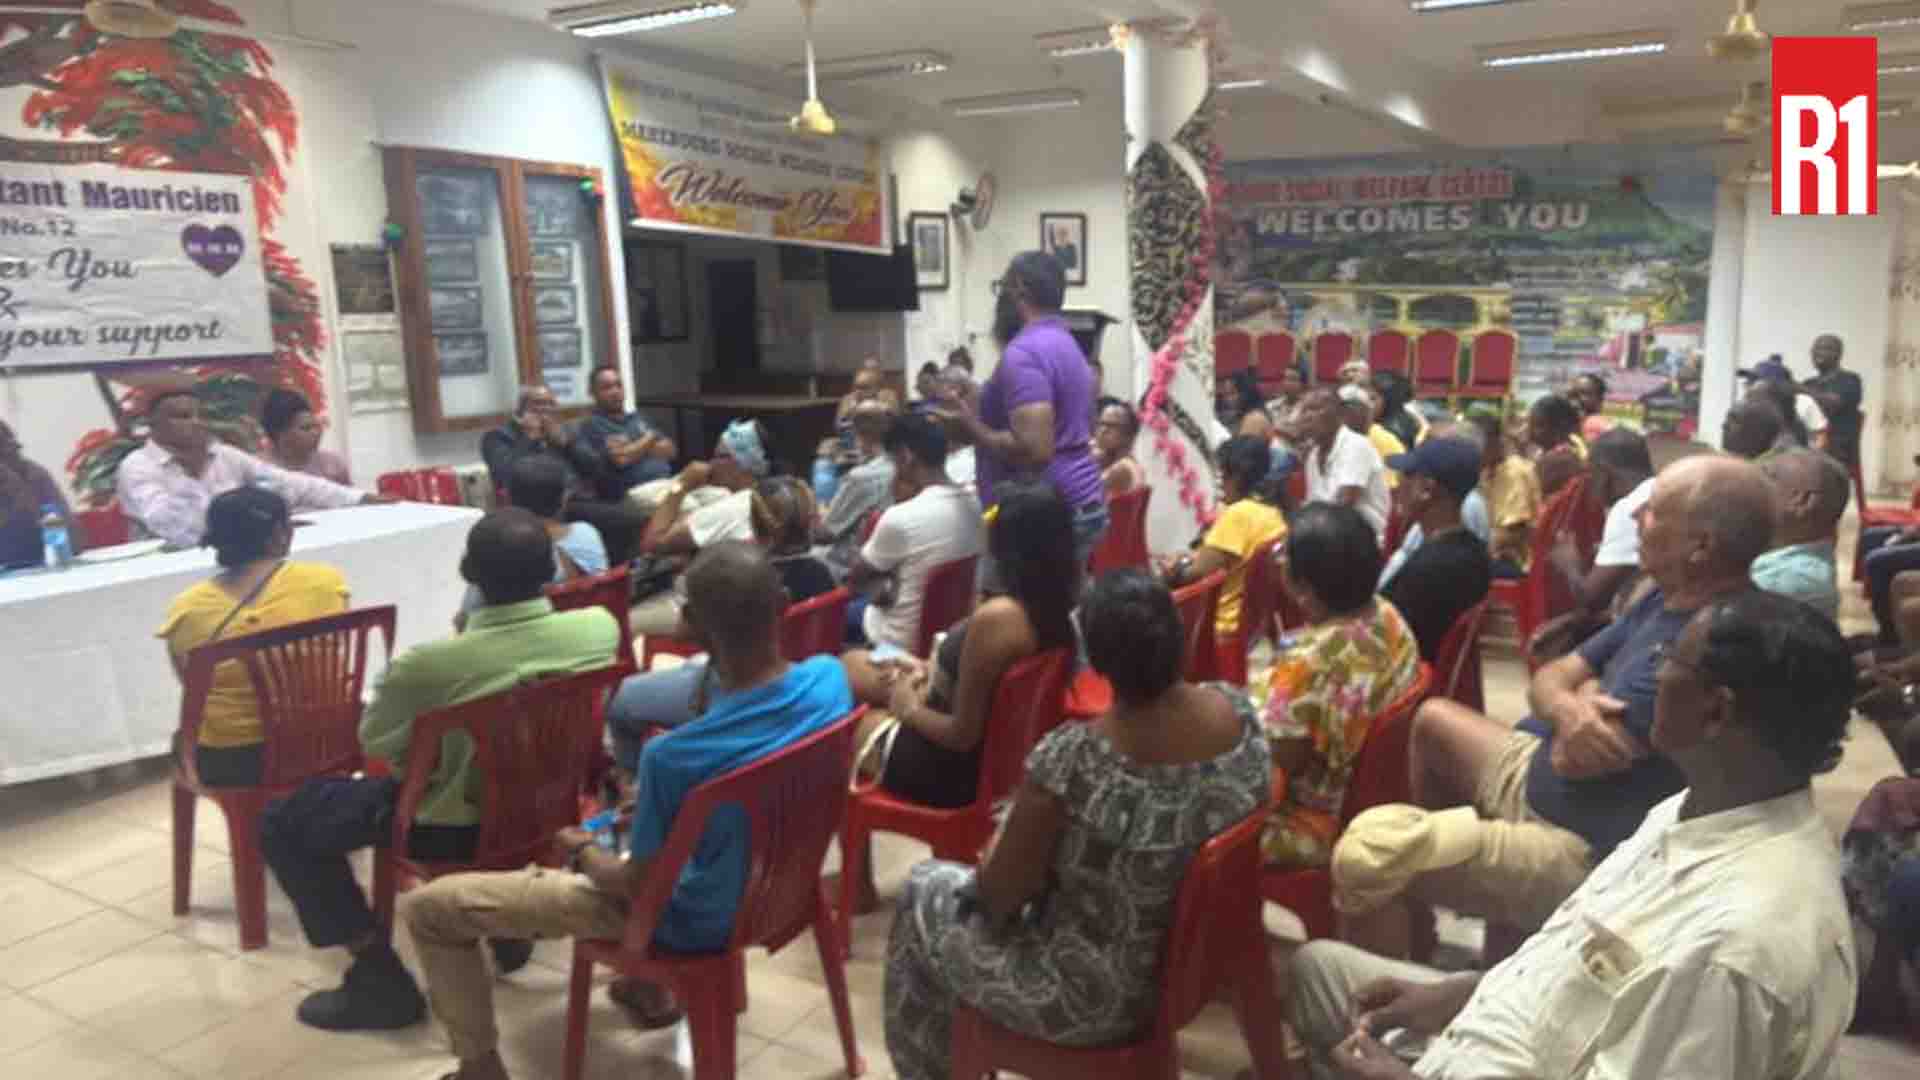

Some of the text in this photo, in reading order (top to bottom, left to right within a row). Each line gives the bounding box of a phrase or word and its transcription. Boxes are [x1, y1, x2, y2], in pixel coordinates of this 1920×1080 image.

[80, 179, 240, 214] Mauricien
[658, 162, 790, 211] Welcome
[1, 217, 77, 237] No.12
[1256, 202, 1590, 235] WELCOMES YOU
[48, 247, 137, 292] You
[0, 319, 223, 361] your support
